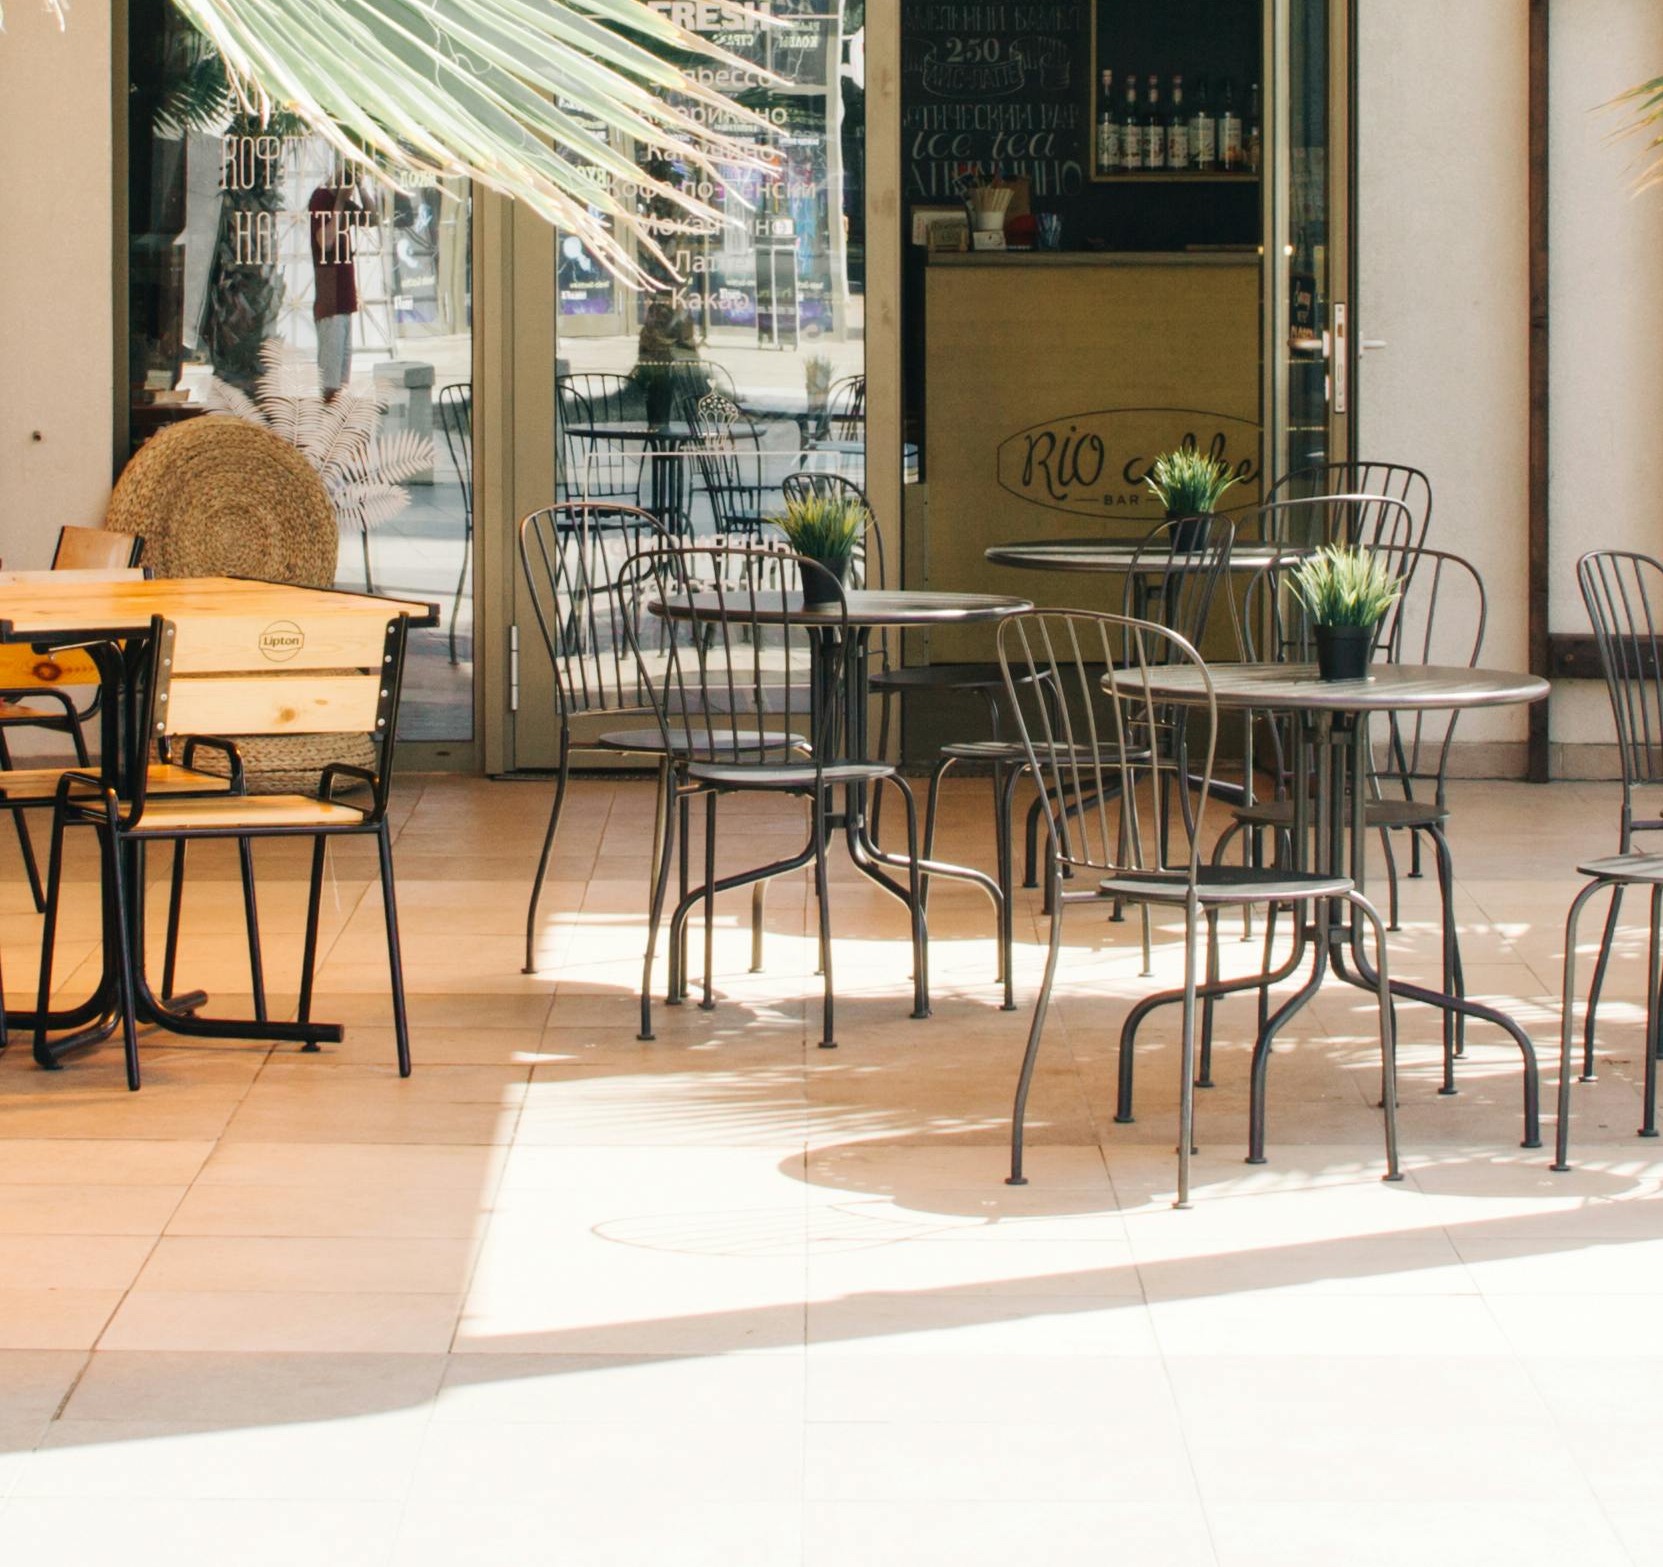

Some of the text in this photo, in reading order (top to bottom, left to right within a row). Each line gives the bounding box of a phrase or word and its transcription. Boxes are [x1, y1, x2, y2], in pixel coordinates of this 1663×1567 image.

[945, 36, 1001, 63] 250
[991, 129, 1056, 159] tea
[672, 288, 750, 311] Какао
[1103, 495, 1141, 507] BAR
[263, 636, 300, 648] Lipton
